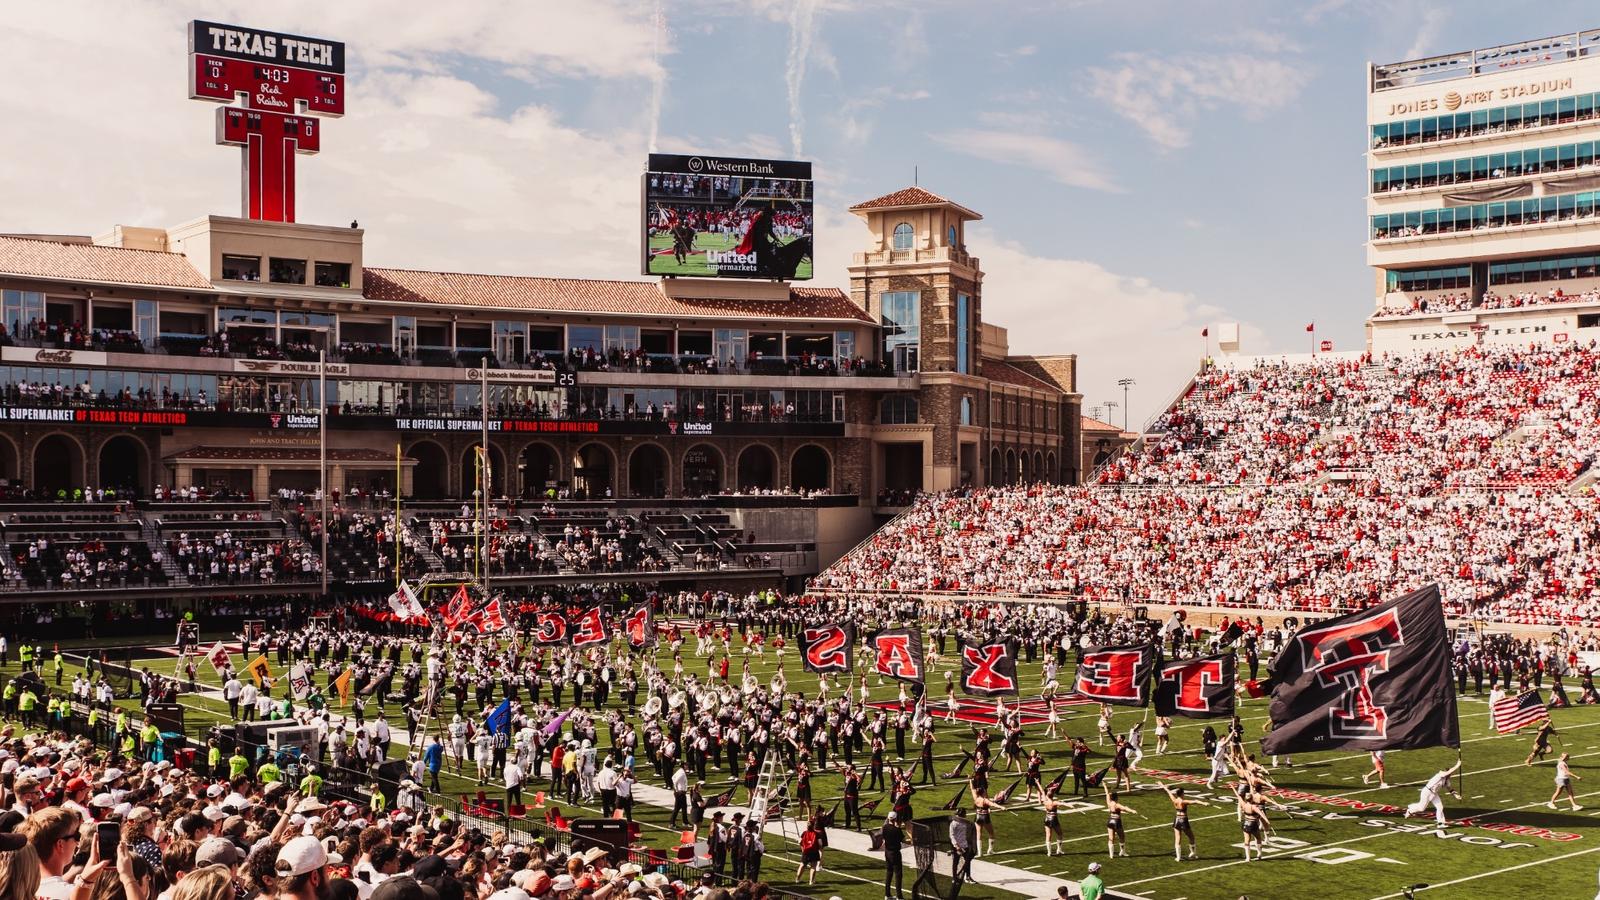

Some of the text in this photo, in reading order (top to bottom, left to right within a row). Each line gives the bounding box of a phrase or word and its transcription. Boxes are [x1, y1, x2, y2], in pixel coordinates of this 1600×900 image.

[208, 27, 333, 66] TEXAS TECH
[212, 67, 219, 78] 0
[262, 68, 289, 83] 4:03
[261, 82, 282, 95] Red
[330, 84, 336, 94] 0
[256, 94, 288, 107] Raiders
[1388, 78, 1572, 116] JONES AT&T STADIUM
[306, 126, 312, 136] 0
[706, 160, 774, 174] Western Bank
[706, 250, 757, 264] United
[1410, 325, 1546, 340] TEXAS TECH
[281, 364, 316, 373] DOUBLE
[480, 369, 508, 379] Lbbock
[510, 371, 536, 379] National
[560, 374, 574, 385] 25
[10, 409, 74, 421] SUPERMARKET
[76, 410, 86, 422] OF
[90, 411, 116, 422] TEXAS
[119, 411, 139, 423] TECH
[142, 412, 186, 424] ATHLETICS
[287, 414, 318, 424] United
[396, 419, 598, 432] THE OFFICIAL SUPERMAKET OF TEXAS TECH ATHLETICS
[1359, 820, 1538, 849] JONES
